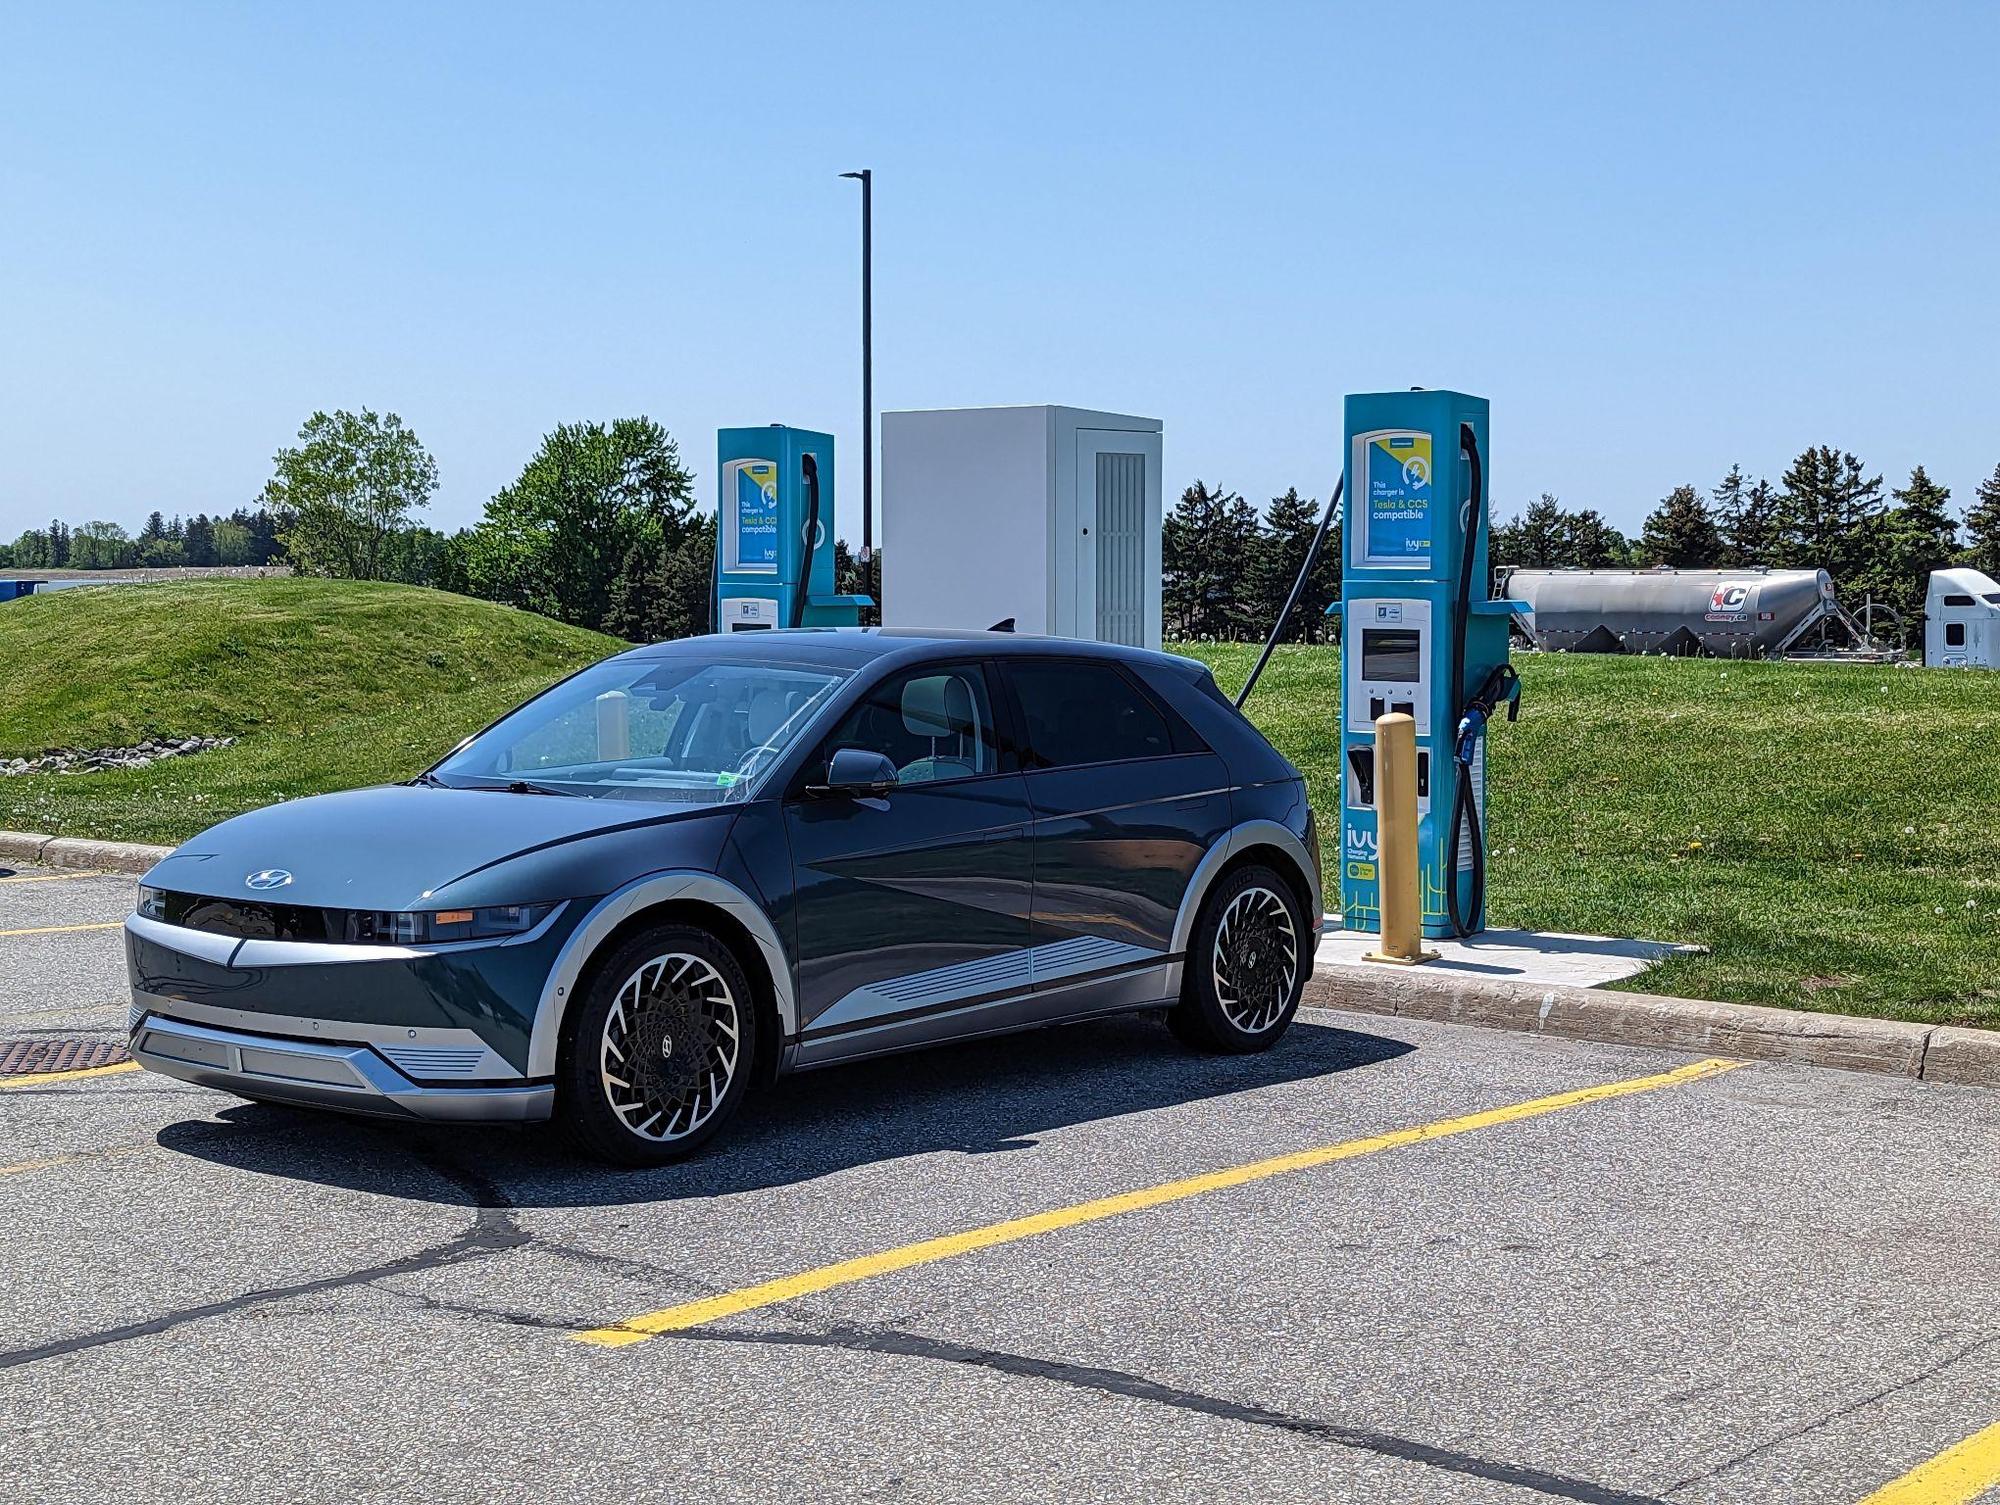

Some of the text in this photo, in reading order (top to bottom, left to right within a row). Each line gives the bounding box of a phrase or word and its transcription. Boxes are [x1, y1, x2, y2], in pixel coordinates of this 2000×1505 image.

[1373, 481, 1386, 489] This
[1373, 489, 1398, 497] charger
[1373, 499, 1428, 509] Tesla & CCS
[1373, 509, 1424, 521] compatible
[742, 516, 758, 526] Tesla
[741, 525, 777, 536] compatible
[1347, 822, 1379, 861] ivy
